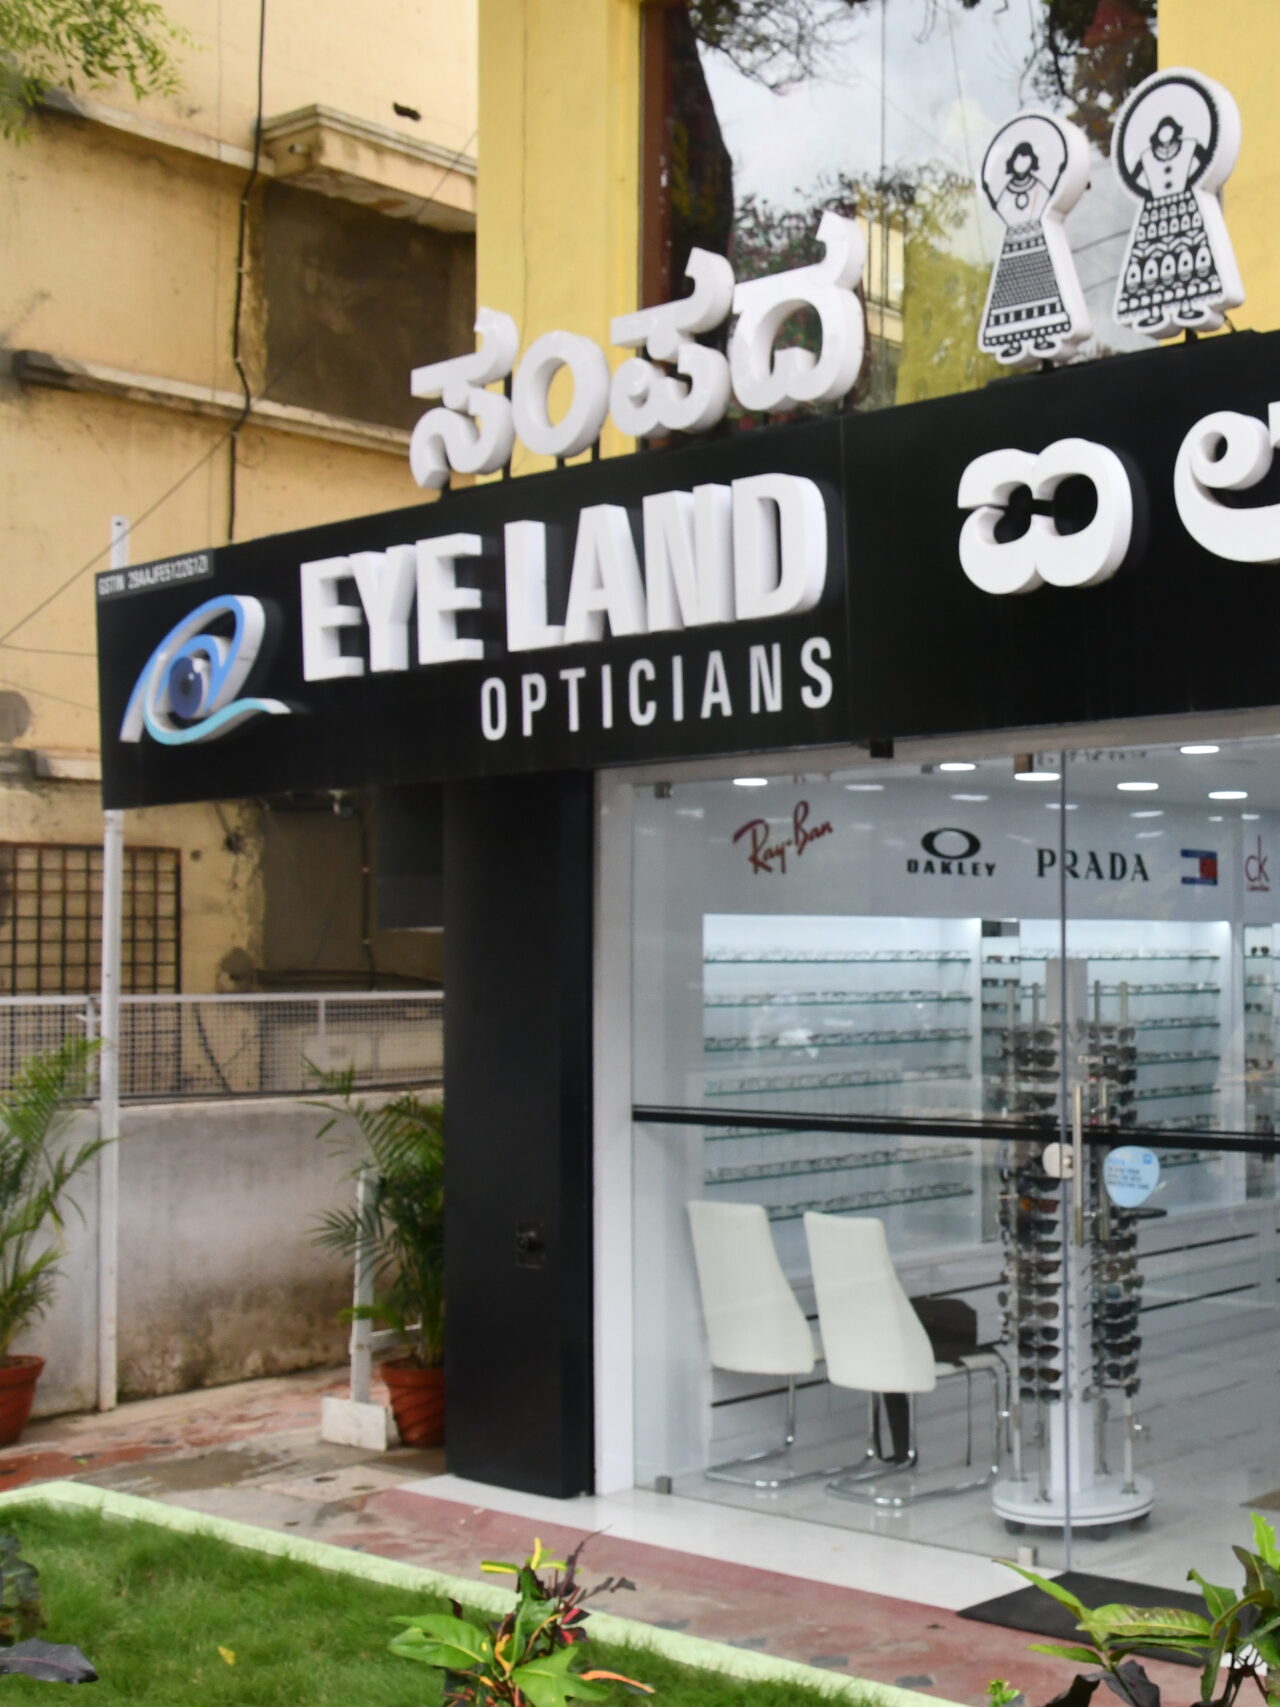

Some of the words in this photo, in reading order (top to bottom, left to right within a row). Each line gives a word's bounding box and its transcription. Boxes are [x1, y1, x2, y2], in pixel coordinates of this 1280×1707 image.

[409, 211, 867, 490] ಸಂಪದ
[300, 532, 483, 682] EYE
[504, 473, 828, 652] LAND
[481, 637, 833, 741] OPTICIANS
[733, 801, 834, 874] Ray-Ban
[907, 858, 996, 877] OAKLEY
[1037, 848, 1149, 882] PRADA
